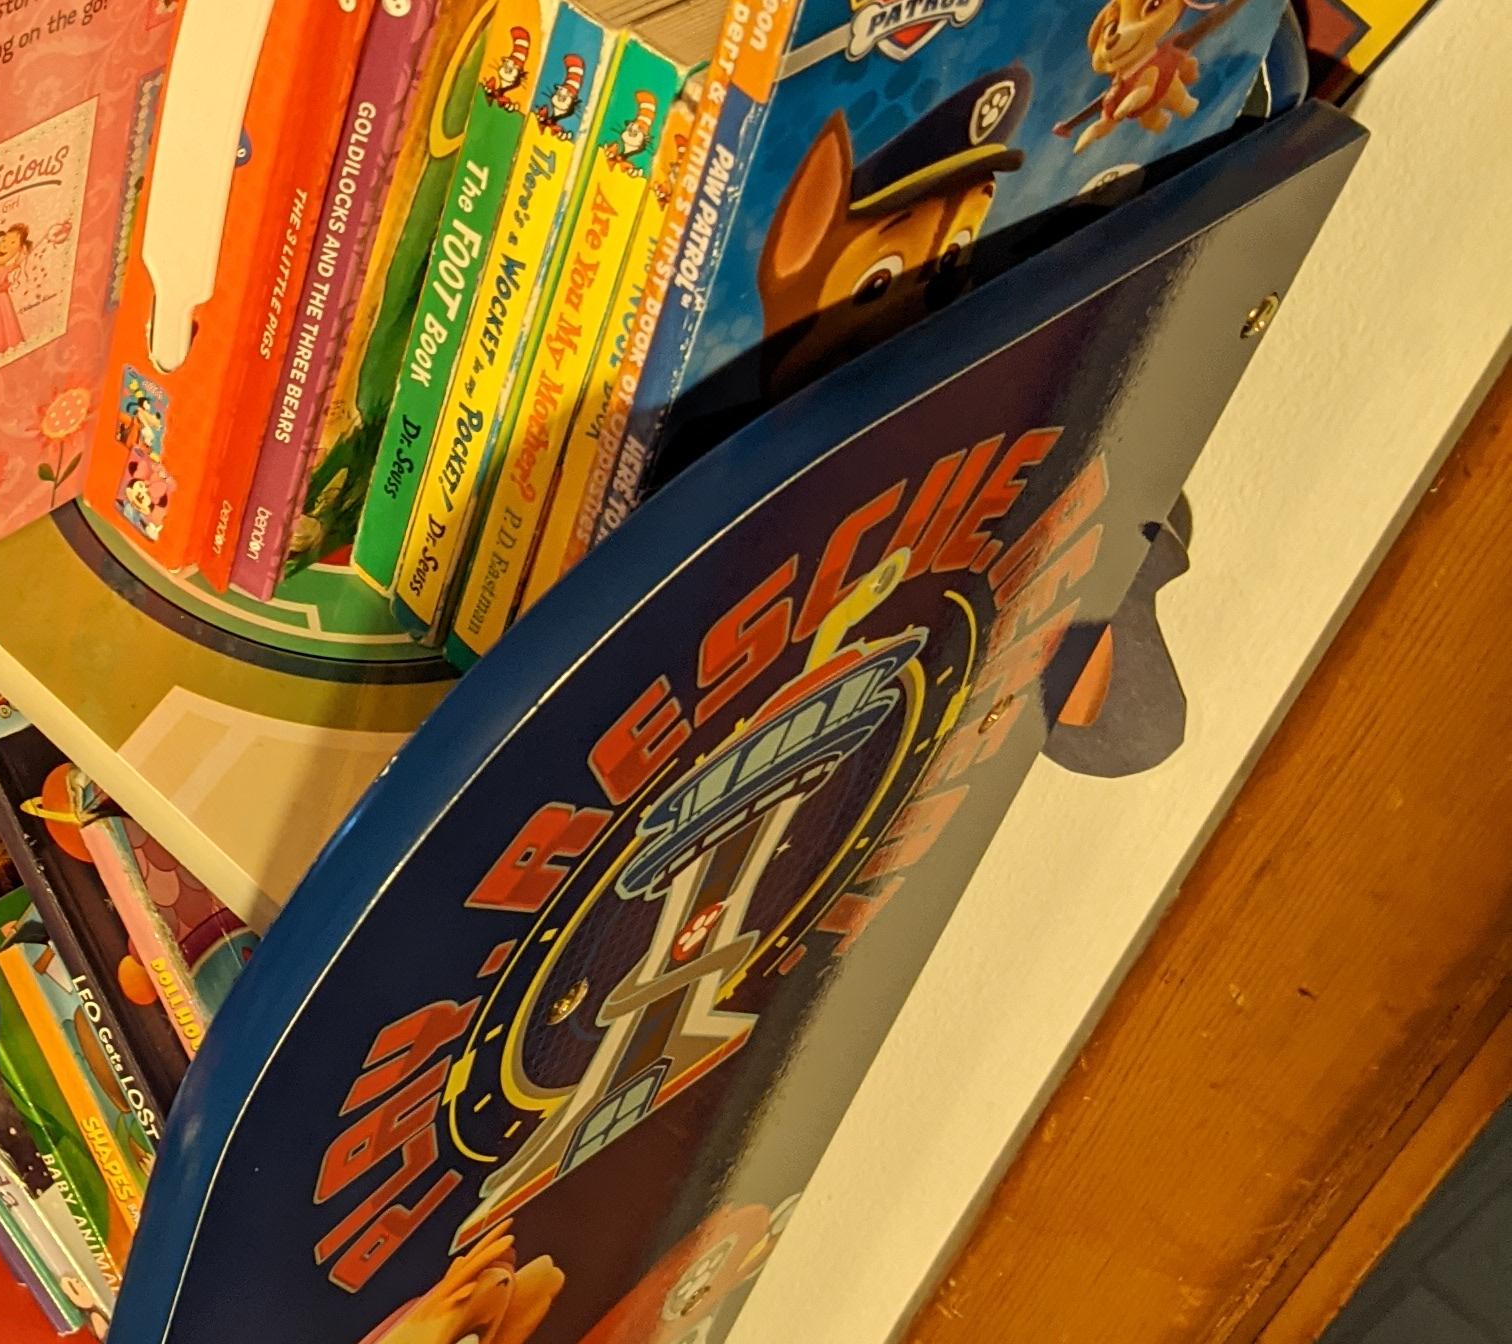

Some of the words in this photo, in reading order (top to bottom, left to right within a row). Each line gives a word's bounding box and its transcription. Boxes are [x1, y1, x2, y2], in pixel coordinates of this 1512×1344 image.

[16, 26, 43, 49] on
[45, 7, 75, 39] the
[327, 100, 378, 236] GOLDILOCKS
[457, 159, 490, 214] The
[514, 144, 557, 231] There's
[707, 142, 735, 205] PAW
[289, 187, 308, 227] THE
[583, 182, 621, 253] Are
[268, 244, 294, 312] LITTLE
[316, 232, 342, 279] AND
[439, 222, 482, 324] FOOT
[674, 202, 719, 299] PATROL
[305, 280, 330, 326] THE
[569, 251, 603, 320] You
[259, 308, 279, 361] PIGS
[289, 324, 320, 386] THREE
[541, 314, 584, 367] My
[274, 383, 301, 446] BEARS
[400, 413, 423, 448] Dr.
[510, 366, 566, 504] Mother?
[247, 506, 273, 562] bendon
[427, 512, 447, 549] Dr.
[467, 549, 512, 637] Eastman
[465, 425, 1066, 913] RESCUE
[73, 974, 102, 1026] LEO
[97, 1025, 126, 1076] Gets
[119, 1073, 161, 1142] LOST
[41, 1152, 76, 1212] BABY
[81, 1115, 136, 1203] SHAPES
